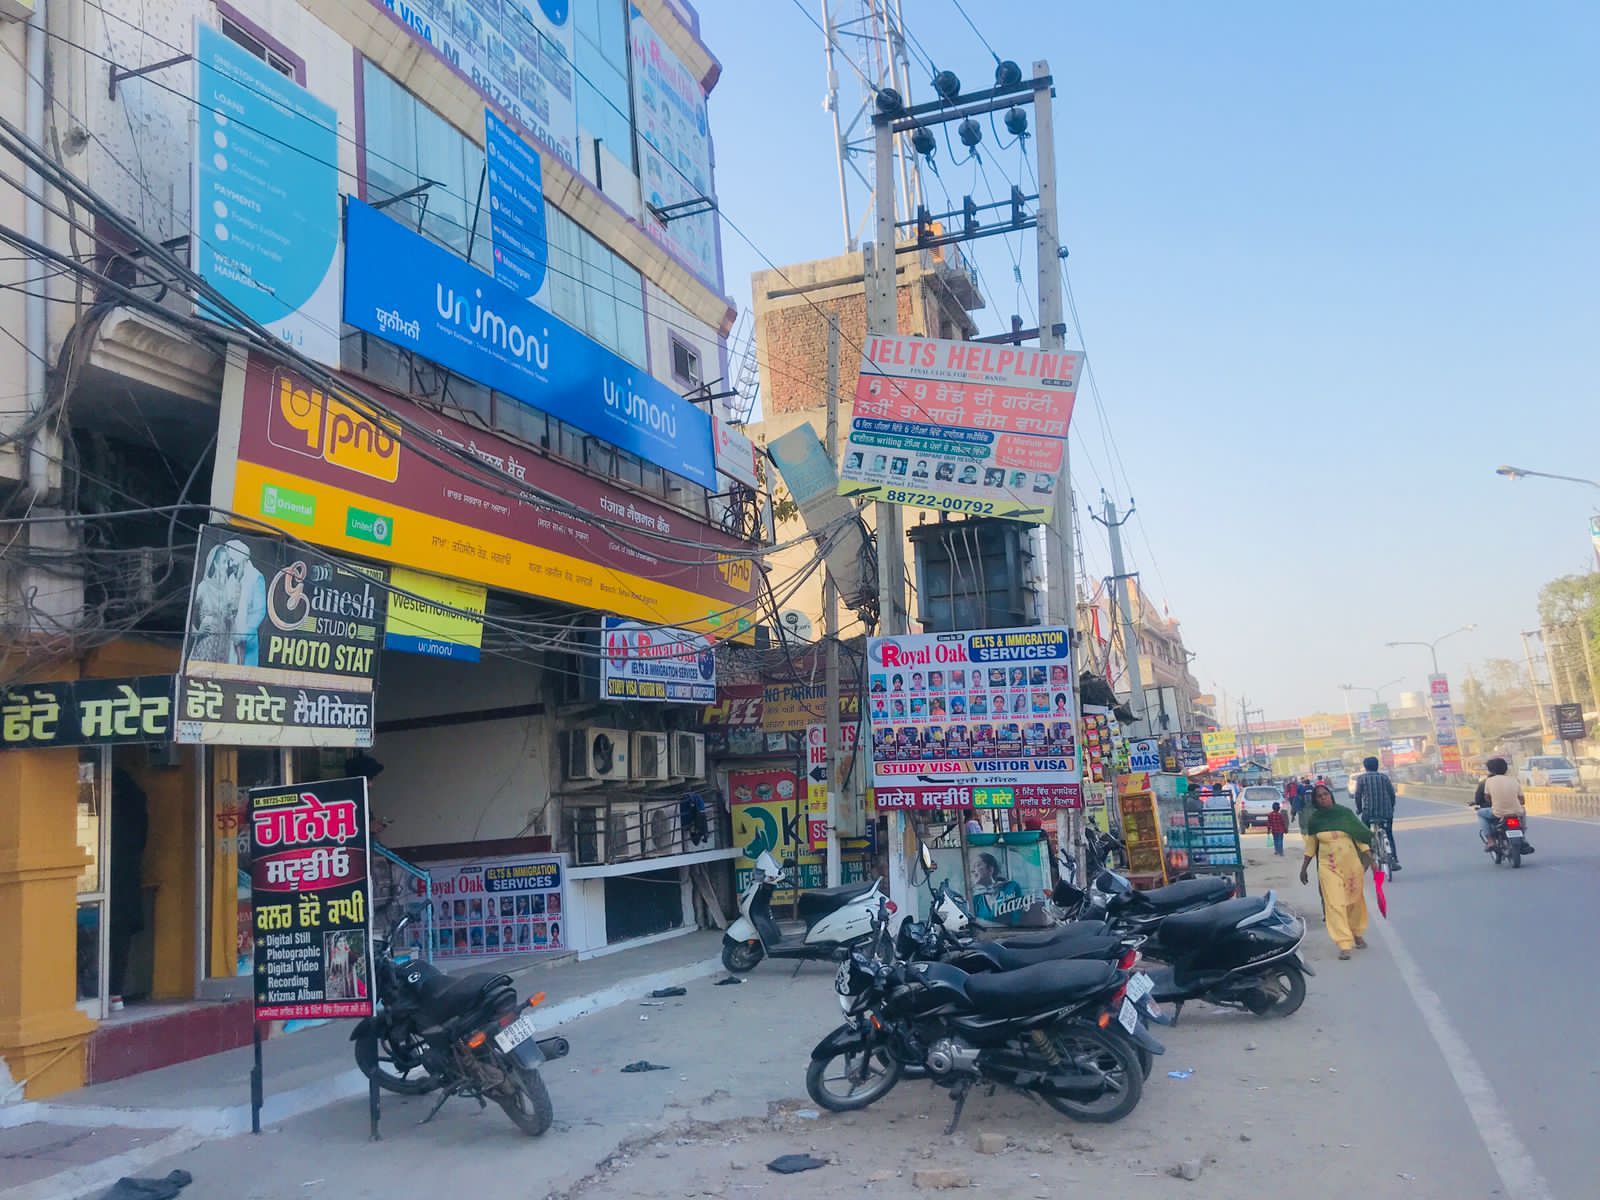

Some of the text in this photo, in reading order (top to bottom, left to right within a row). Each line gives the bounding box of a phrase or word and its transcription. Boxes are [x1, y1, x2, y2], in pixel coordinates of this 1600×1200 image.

[400, 7, 432, 44] VISA
[436, 281, 550, 370] unimoni
[870, 338, 1078, 381] IELTS HELPLINE
[869, 379, 881, 397] 6
[914, 383, 928, 401] 9
[603, 375, 676, 438] unimoni
[330, 410, 395, 459] pnb
[886, 489, 994, 515] 88722-00792
[351, 518, 373, 533] United
[316, 617, 358, 637] STUDIO
[417, 640, 453, 657] unimoni
[971, 631, 1063, 649] IELTS & IMMIGRATION
[268, 635, 374, 673] PHOTO STAT
[881, 640, 968, 670] Royal Oak
[979, 645, 1057, 661] SERVICES
[186, 679, 225, 719] ਫੋਟੋ
[235, 685, 286, 723] ਸਟੇਟ
[784, 685, 827, 700] PARKIN
[2, 684, 171, 742] ਫੋਟੋ ਸਟੇਟ
[823, 725, 856, 744] ITS
[883, 759, 1067, 774] STUDY VISA VISITOR VISA
[265, 847, 350, 891] ਸਟੂਡੀਓ
[487, 862, 557, 880] IELTS & IMMIGRATION
[459, 874, 485, 894] Oak
[493, 875, 553, 891] SERVICES
[256, 904, 293, 931] ਕਲਰ
[327, 889, 365, 925] ਕਾਪੀ
[266, 931, 311, 948] Digital Still
[266, 945, 321, 961] Photographic
[267, 960, 319, 976] Digital Video
[267, 976, 309, 989] Recording
[268, 988, 324, 1002] Krizma Album
